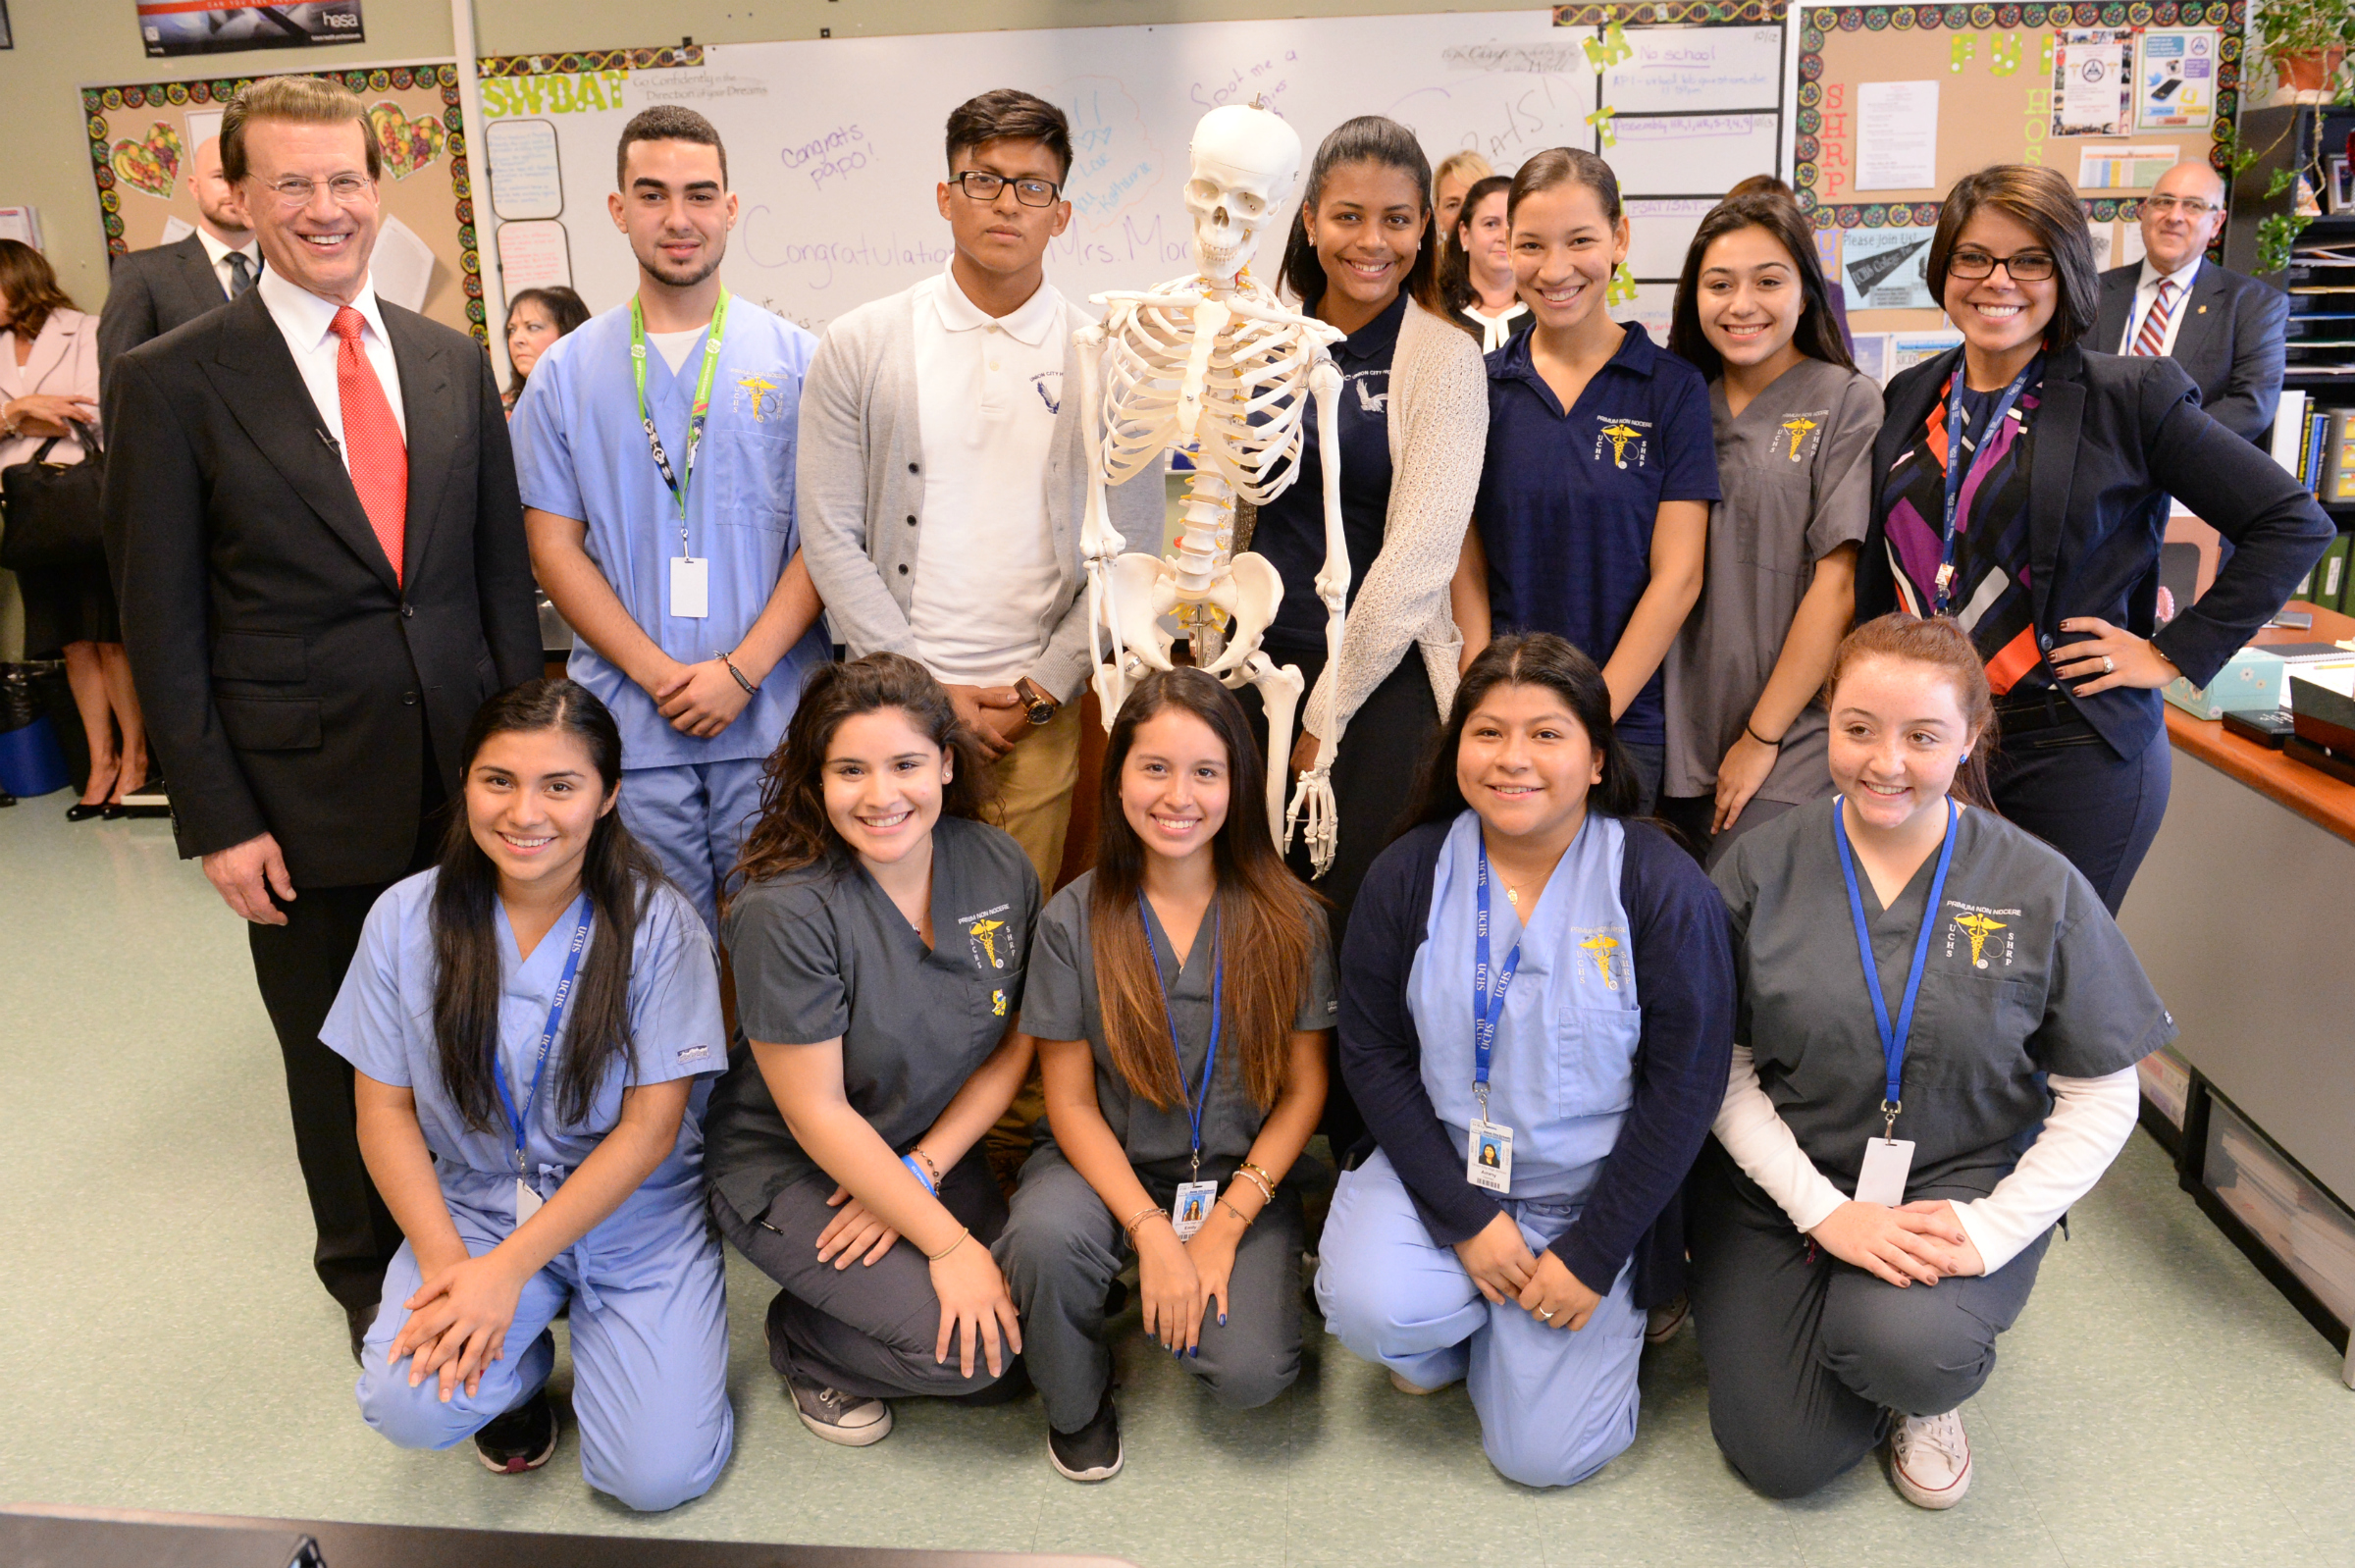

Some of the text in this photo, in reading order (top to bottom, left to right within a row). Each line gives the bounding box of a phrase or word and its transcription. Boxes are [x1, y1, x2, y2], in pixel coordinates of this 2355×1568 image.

[323, 11, 359, 27] hosa
[1641, 44, 1716, 60] No school
[652, 71, 714, 86] Confidently
[727, 85, 768, 96] Dreams
[1191, 69, 1244, 111] Spot
[1250, 60, 1273, 77] me
[481, 69, 629, 118] SWBAT
[781, 125, 864, 169] Congrats
[1821, 83, 1849, 196] SHRP
[1050, 217, 1121, 267] Mrs.
[1845, 235, 1874, 246] Please
[1876, 235, 1898, 247] Join
[1596, 414, 1618, 424] PRIMUM
[1631, 419, 1653, 428] NOCERE
[1595, 435, 1603, 460] UCHS
[1639, 440, 1648, 467] SHRP
[1769, 429, 1783, 453] UCHS
[1809, 429, 1821, 457] SHRP
[976, 910, 989, 919] NON
[988, 903, 1011, 916] NOCERE
[1947, 900, 1975, 912] PRIMUM
[1975, 906, 1992, 915] NON
[1479, 910, 1488, 937] UCHS
[572, 925, 588, 954] UCHS
[969, 938, 982, 969] UCHS
[1005, 925, 1016, 957] SHRP
[1946, 923, 1957, 958] UCHS
[2005, 932, 2015, 966] SHRP
[1477, 963, 1487, 991] UCHS
[1576, 950, 1586, 984] UCHS
[1621, 951, 1631, 985] SHRP
[553, 979, 571, 1009] UCHS
[1494, 969, 1512, 999] UCHS
[538, 1034, 551, 1063] UCHS
[1480, 1022, 1495, 1051] UCHS
